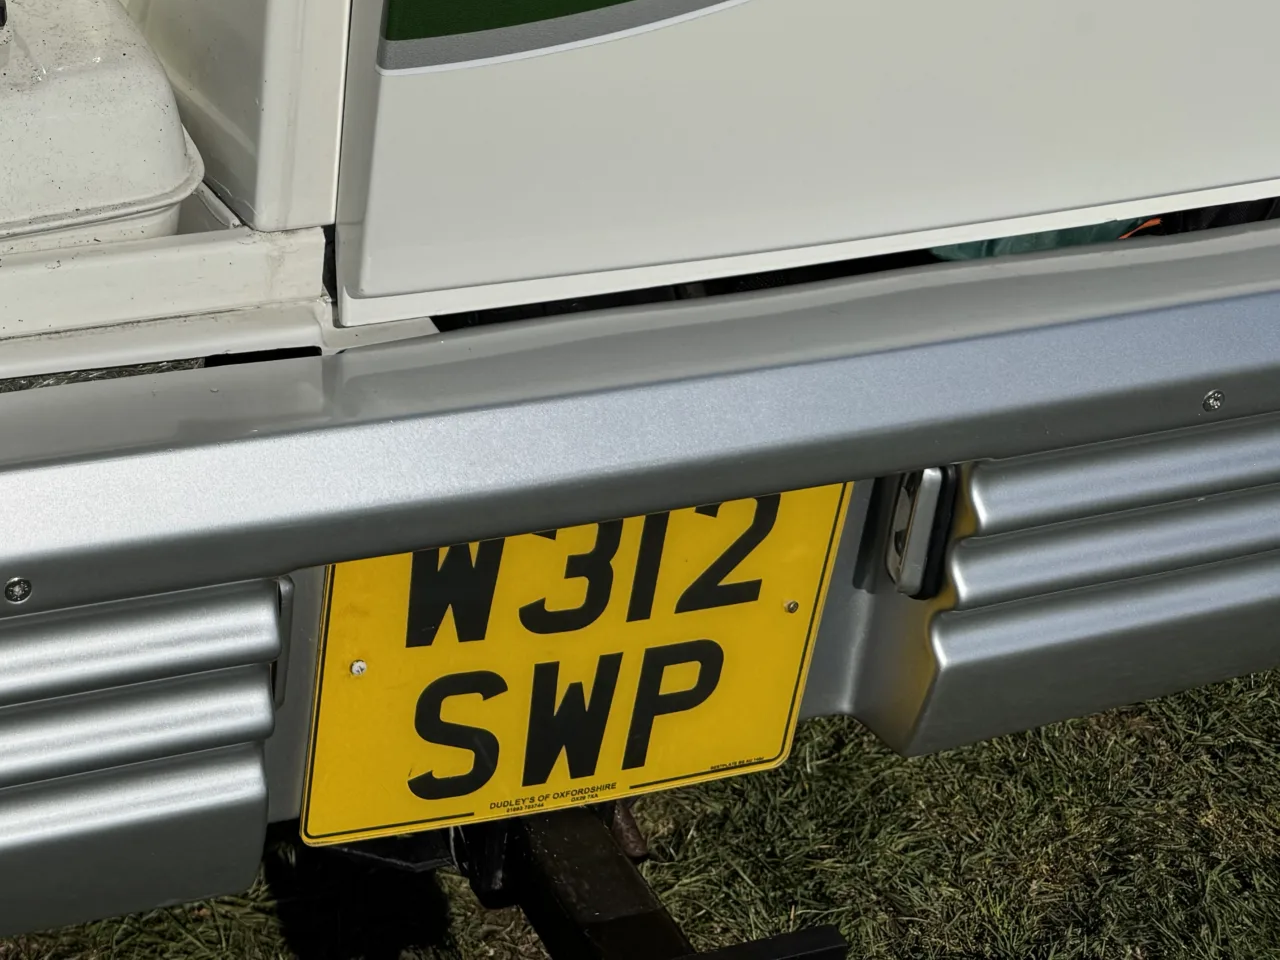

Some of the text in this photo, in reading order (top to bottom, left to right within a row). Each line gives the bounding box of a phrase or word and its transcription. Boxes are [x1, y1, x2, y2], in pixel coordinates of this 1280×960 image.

[405, 493, 781, 648] W312
[408, 639, 724, 800] SWP
[489, 782, 617, 809] DUDLEY'S OF OXFORDSHIRE
